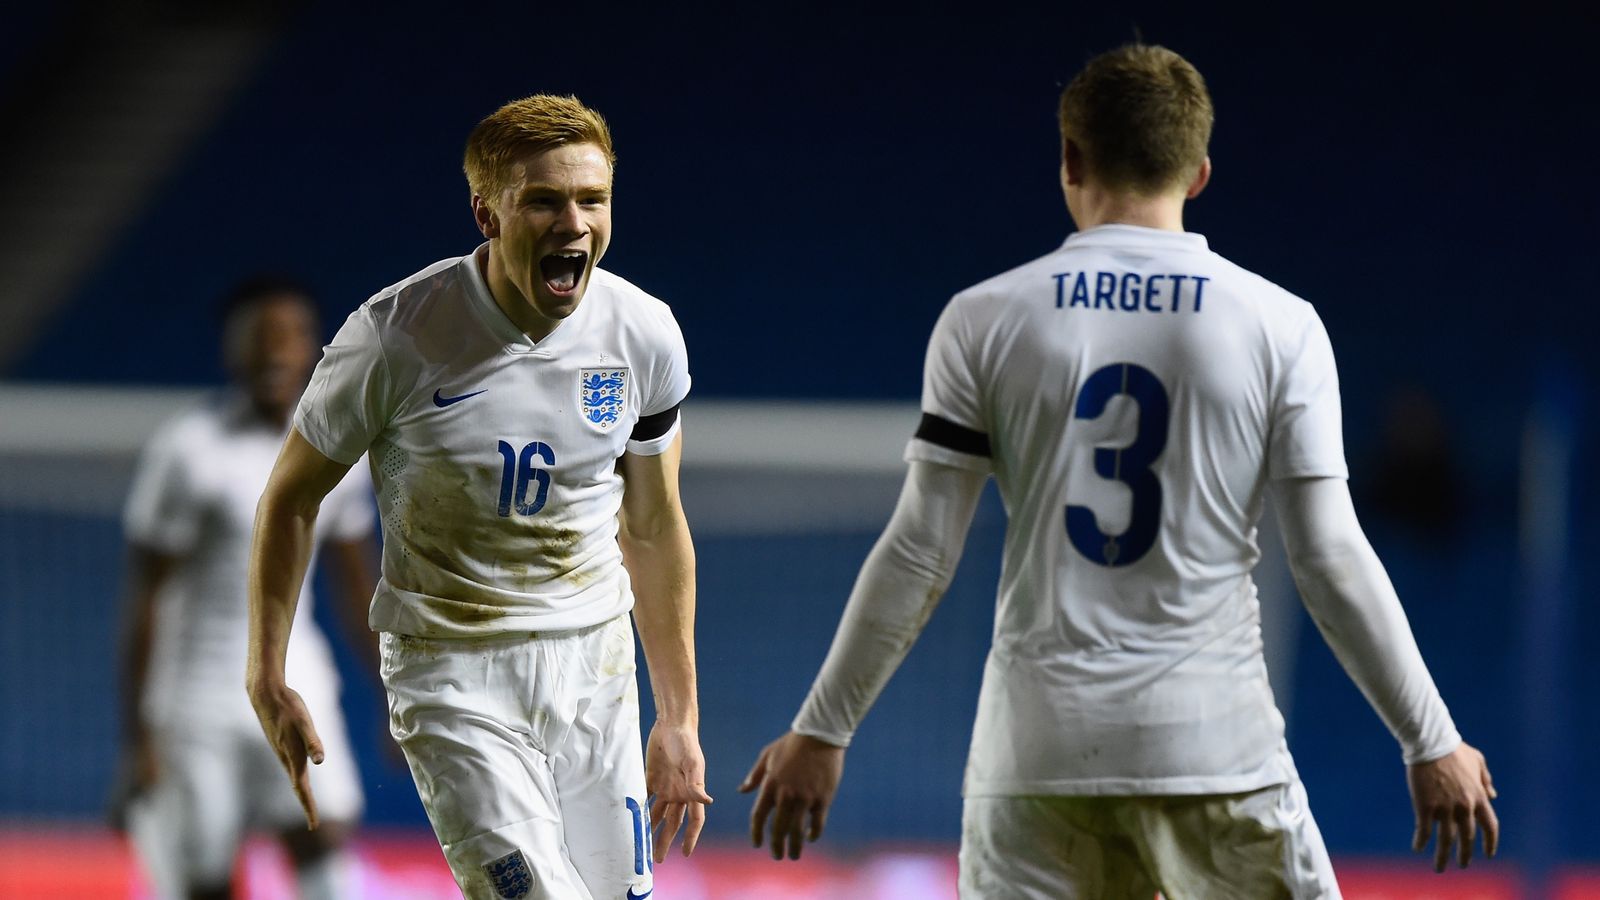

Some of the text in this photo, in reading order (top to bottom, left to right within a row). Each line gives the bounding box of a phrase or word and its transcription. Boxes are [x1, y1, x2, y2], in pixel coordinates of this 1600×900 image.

[1052, 271, 1210, 313] TARGETT
[497, 439, 556, 518] 16
[1064, 362, 1170, 568] 3
